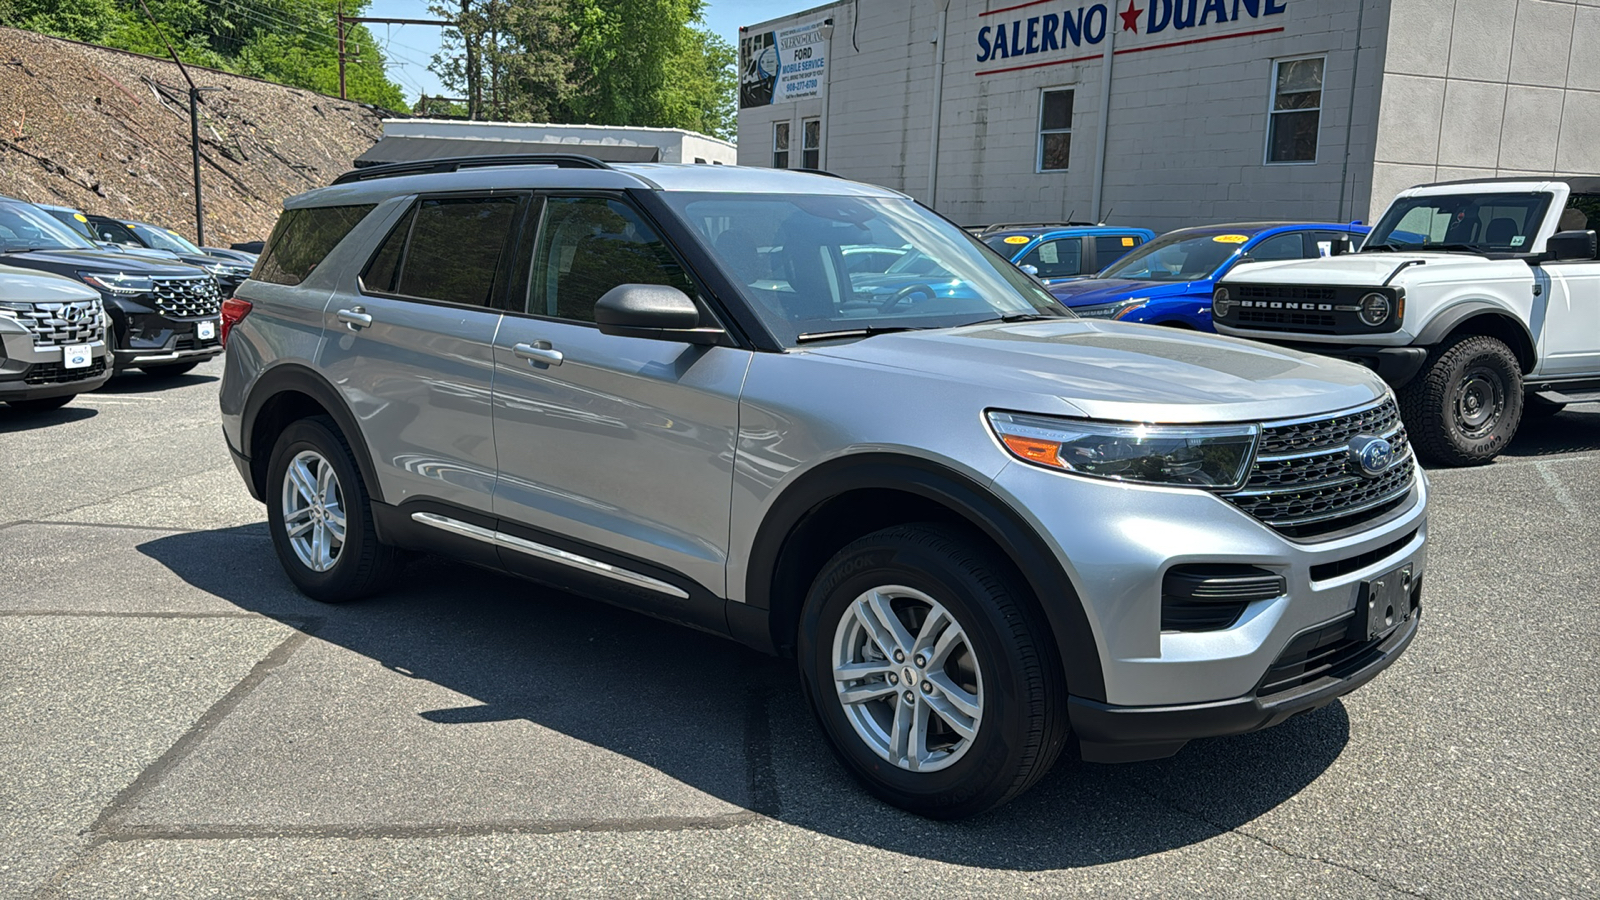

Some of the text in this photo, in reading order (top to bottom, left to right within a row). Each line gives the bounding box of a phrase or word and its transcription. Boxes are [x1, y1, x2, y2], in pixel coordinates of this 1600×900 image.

[976, 4, 1108, 62] SALERNO
[794, 47, 812, 61] FORD
[782, 57, 824, 74] MOBILE SERVICE
[1241, 300, 1332, 311] BRONCO
